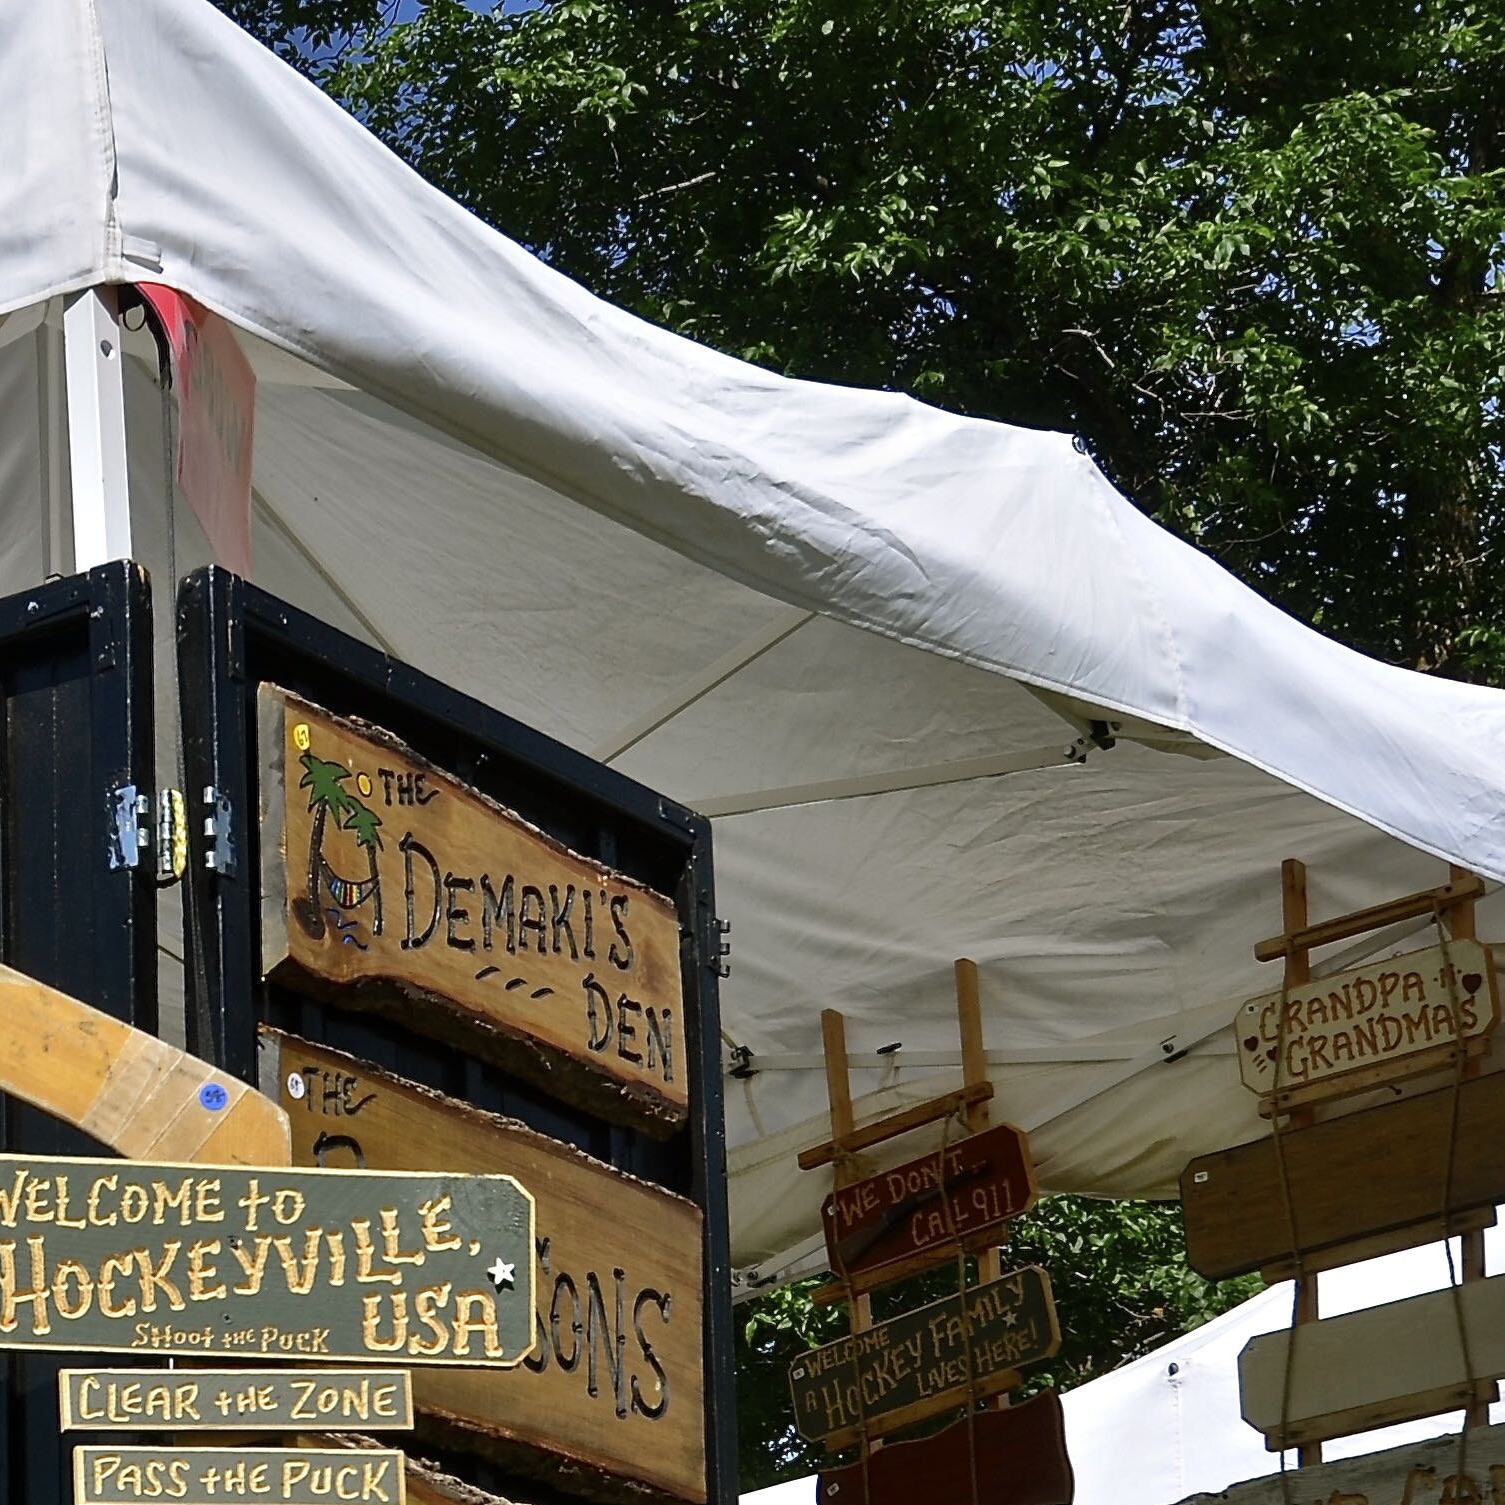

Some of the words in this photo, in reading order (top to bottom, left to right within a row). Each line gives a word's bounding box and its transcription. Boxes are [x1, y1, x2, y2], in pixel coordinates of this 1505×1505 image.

[378, 768, 440, 807] THE
[398, 831, 634, 970] DEMAKI'S
[583, 973, 674, 1082] DEN
[1259, 971, 1426, 1044] GRANDPA
[303, 1066, 378, 1115] THE
[838, 1180, 879, 1227] WE
[972, 1180, 1017, 1222] 911
[260, 1326, 331, 1355] PUCK
[362, 1282, 504, 1359] USA
[803, 1328, 892, 1379] WELCOME
[821, 1333, 925, 1429] HOCKEY
[929, 1278, 1025, 1358] FAMILY
[917, 1355, 970, 1398] LIVES
[974, 1322, 1038, 1372] HERE!
[77, 1377, 201, 1422] CLEAR
[290, 1380, 398, 1422] ZONE
[94, 1455, 191, 1499] PASS
[282, 1461, 390, 1501] PUCK
